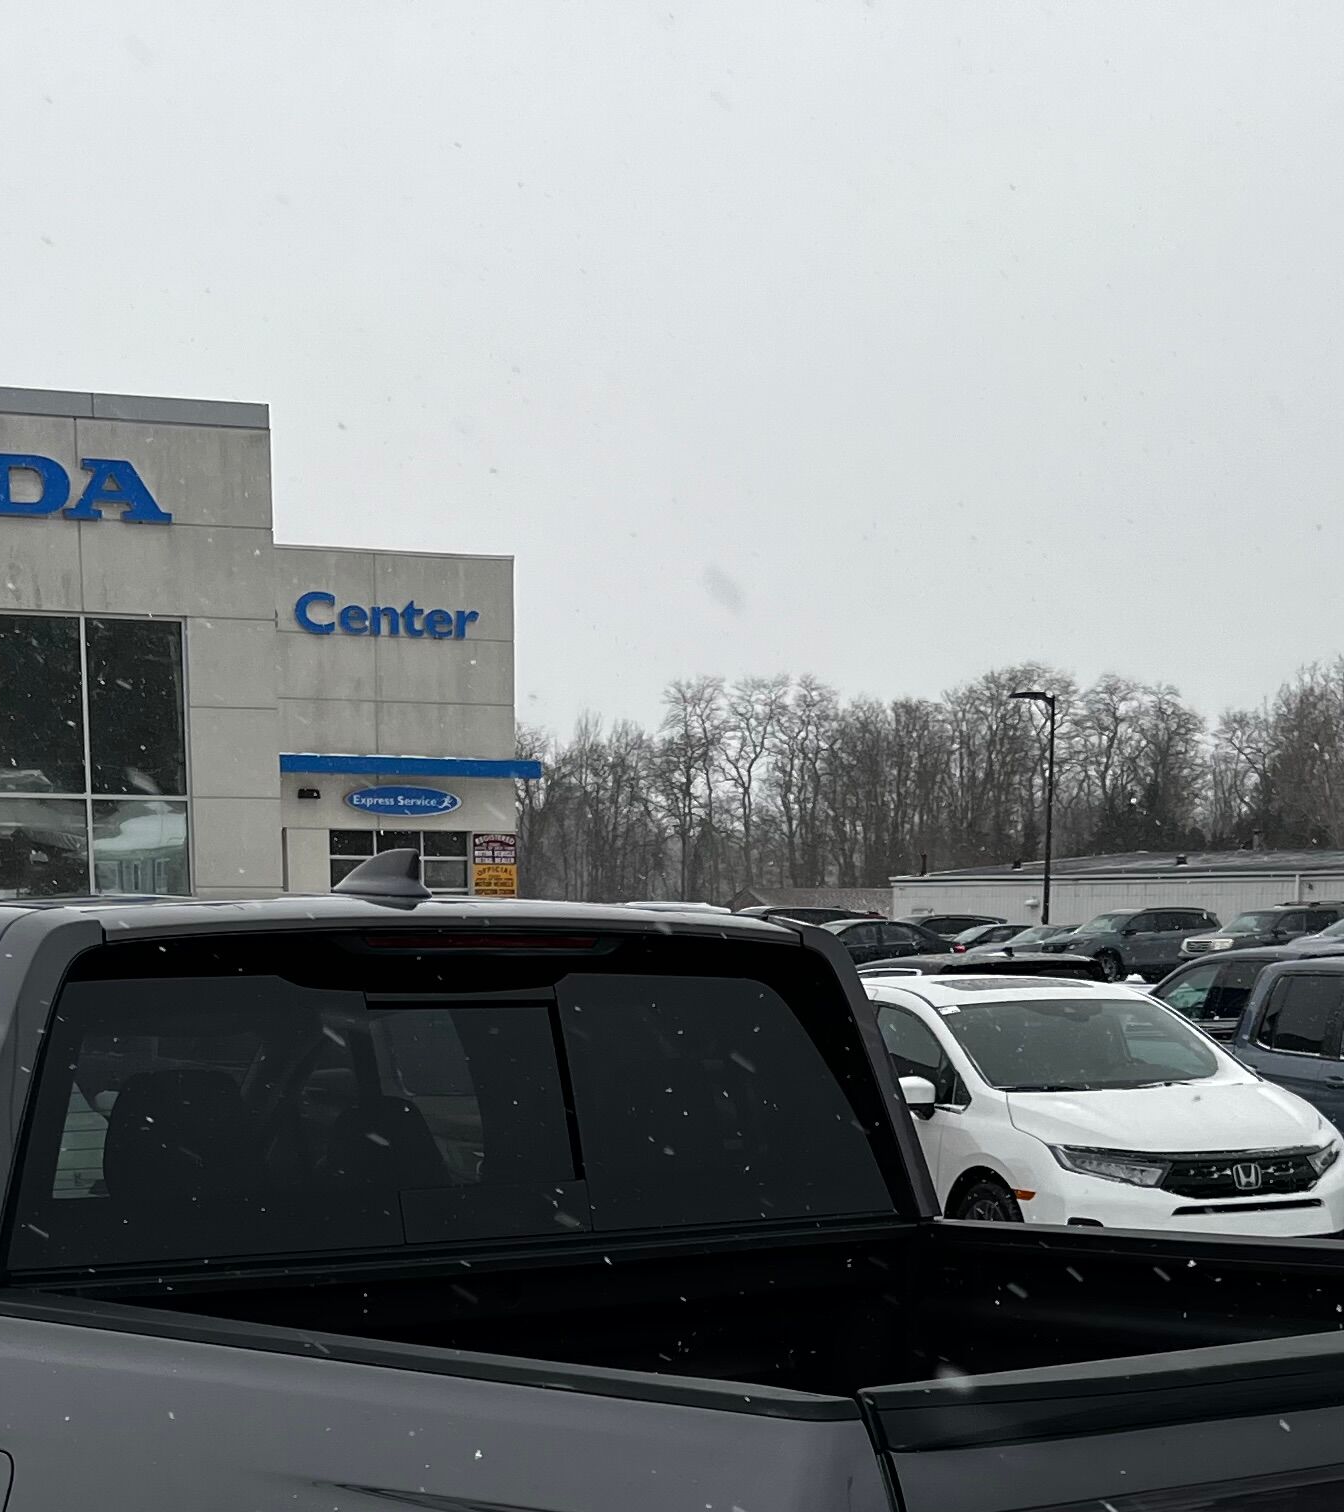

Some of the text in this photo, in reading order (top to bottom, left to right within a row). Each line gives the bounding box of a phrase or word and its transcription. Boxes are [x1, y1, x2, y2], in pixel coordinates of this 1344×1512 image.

[294, 591, 480, 640] Center
[353, 795, 437, 807] Express Service
[475, 834, 515, 845] REGISTERED
[477, 866, 513, 876] OFFICIAL
